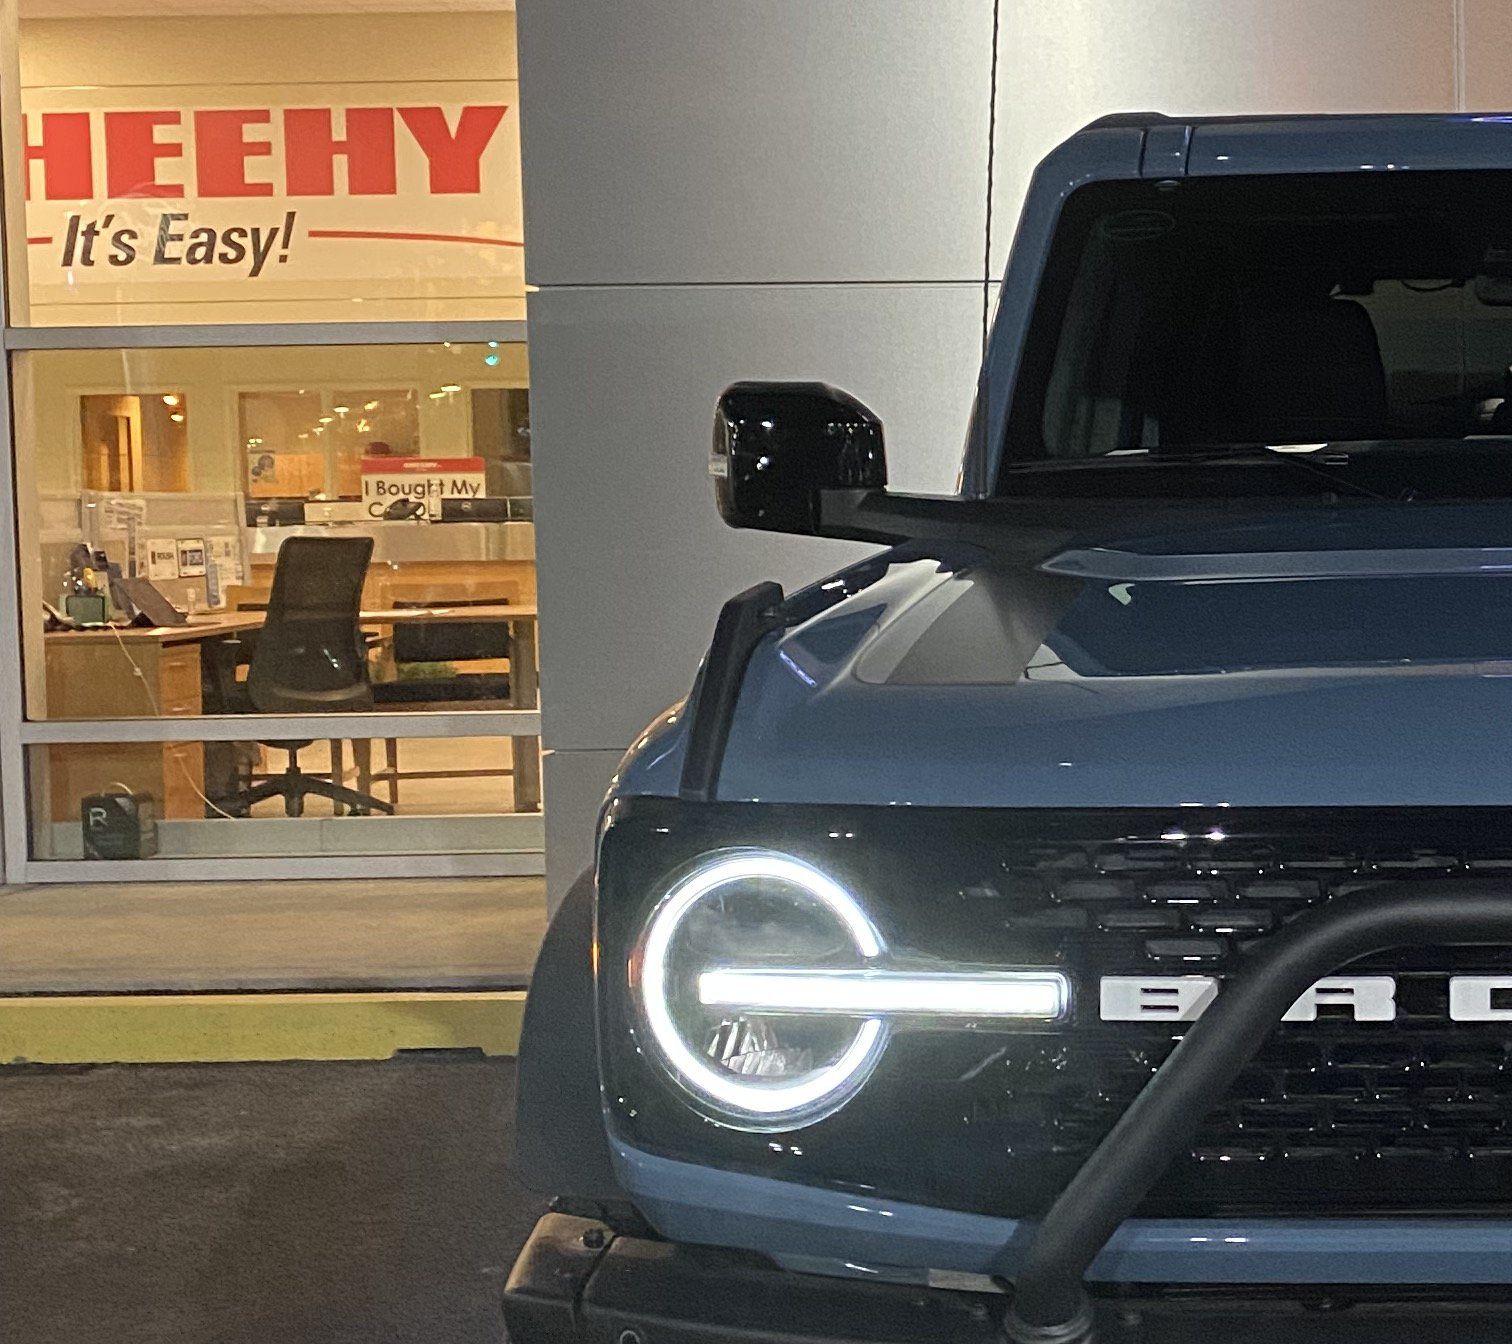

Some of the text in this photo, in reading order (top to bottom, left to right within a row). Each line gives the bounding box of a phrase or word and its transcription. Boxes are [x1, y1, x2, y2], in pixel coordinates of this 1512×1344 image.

[60, 211, 297, 278] It's Easy!
[365, 479, 481, 500] I Bought My
